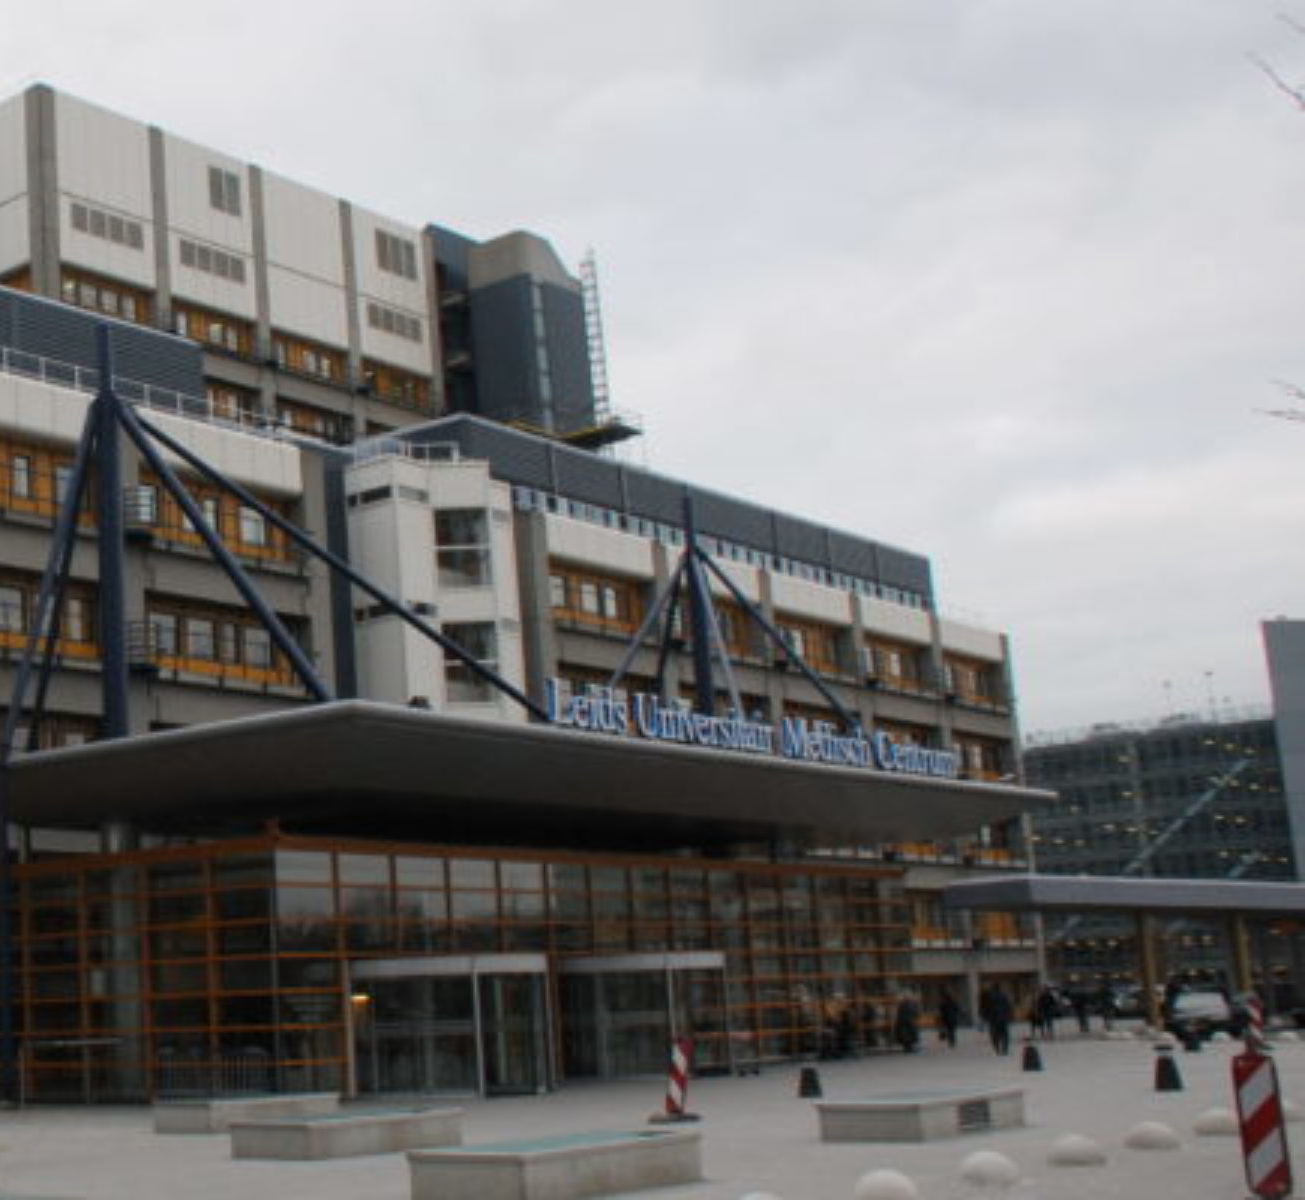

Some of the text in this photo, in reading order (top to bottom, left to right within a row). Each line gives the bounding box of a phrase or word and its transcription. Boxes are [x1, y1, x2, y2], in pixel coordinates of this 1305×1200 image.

[545, 677, 959, 778] Leids Universitair Medisch Centrum
